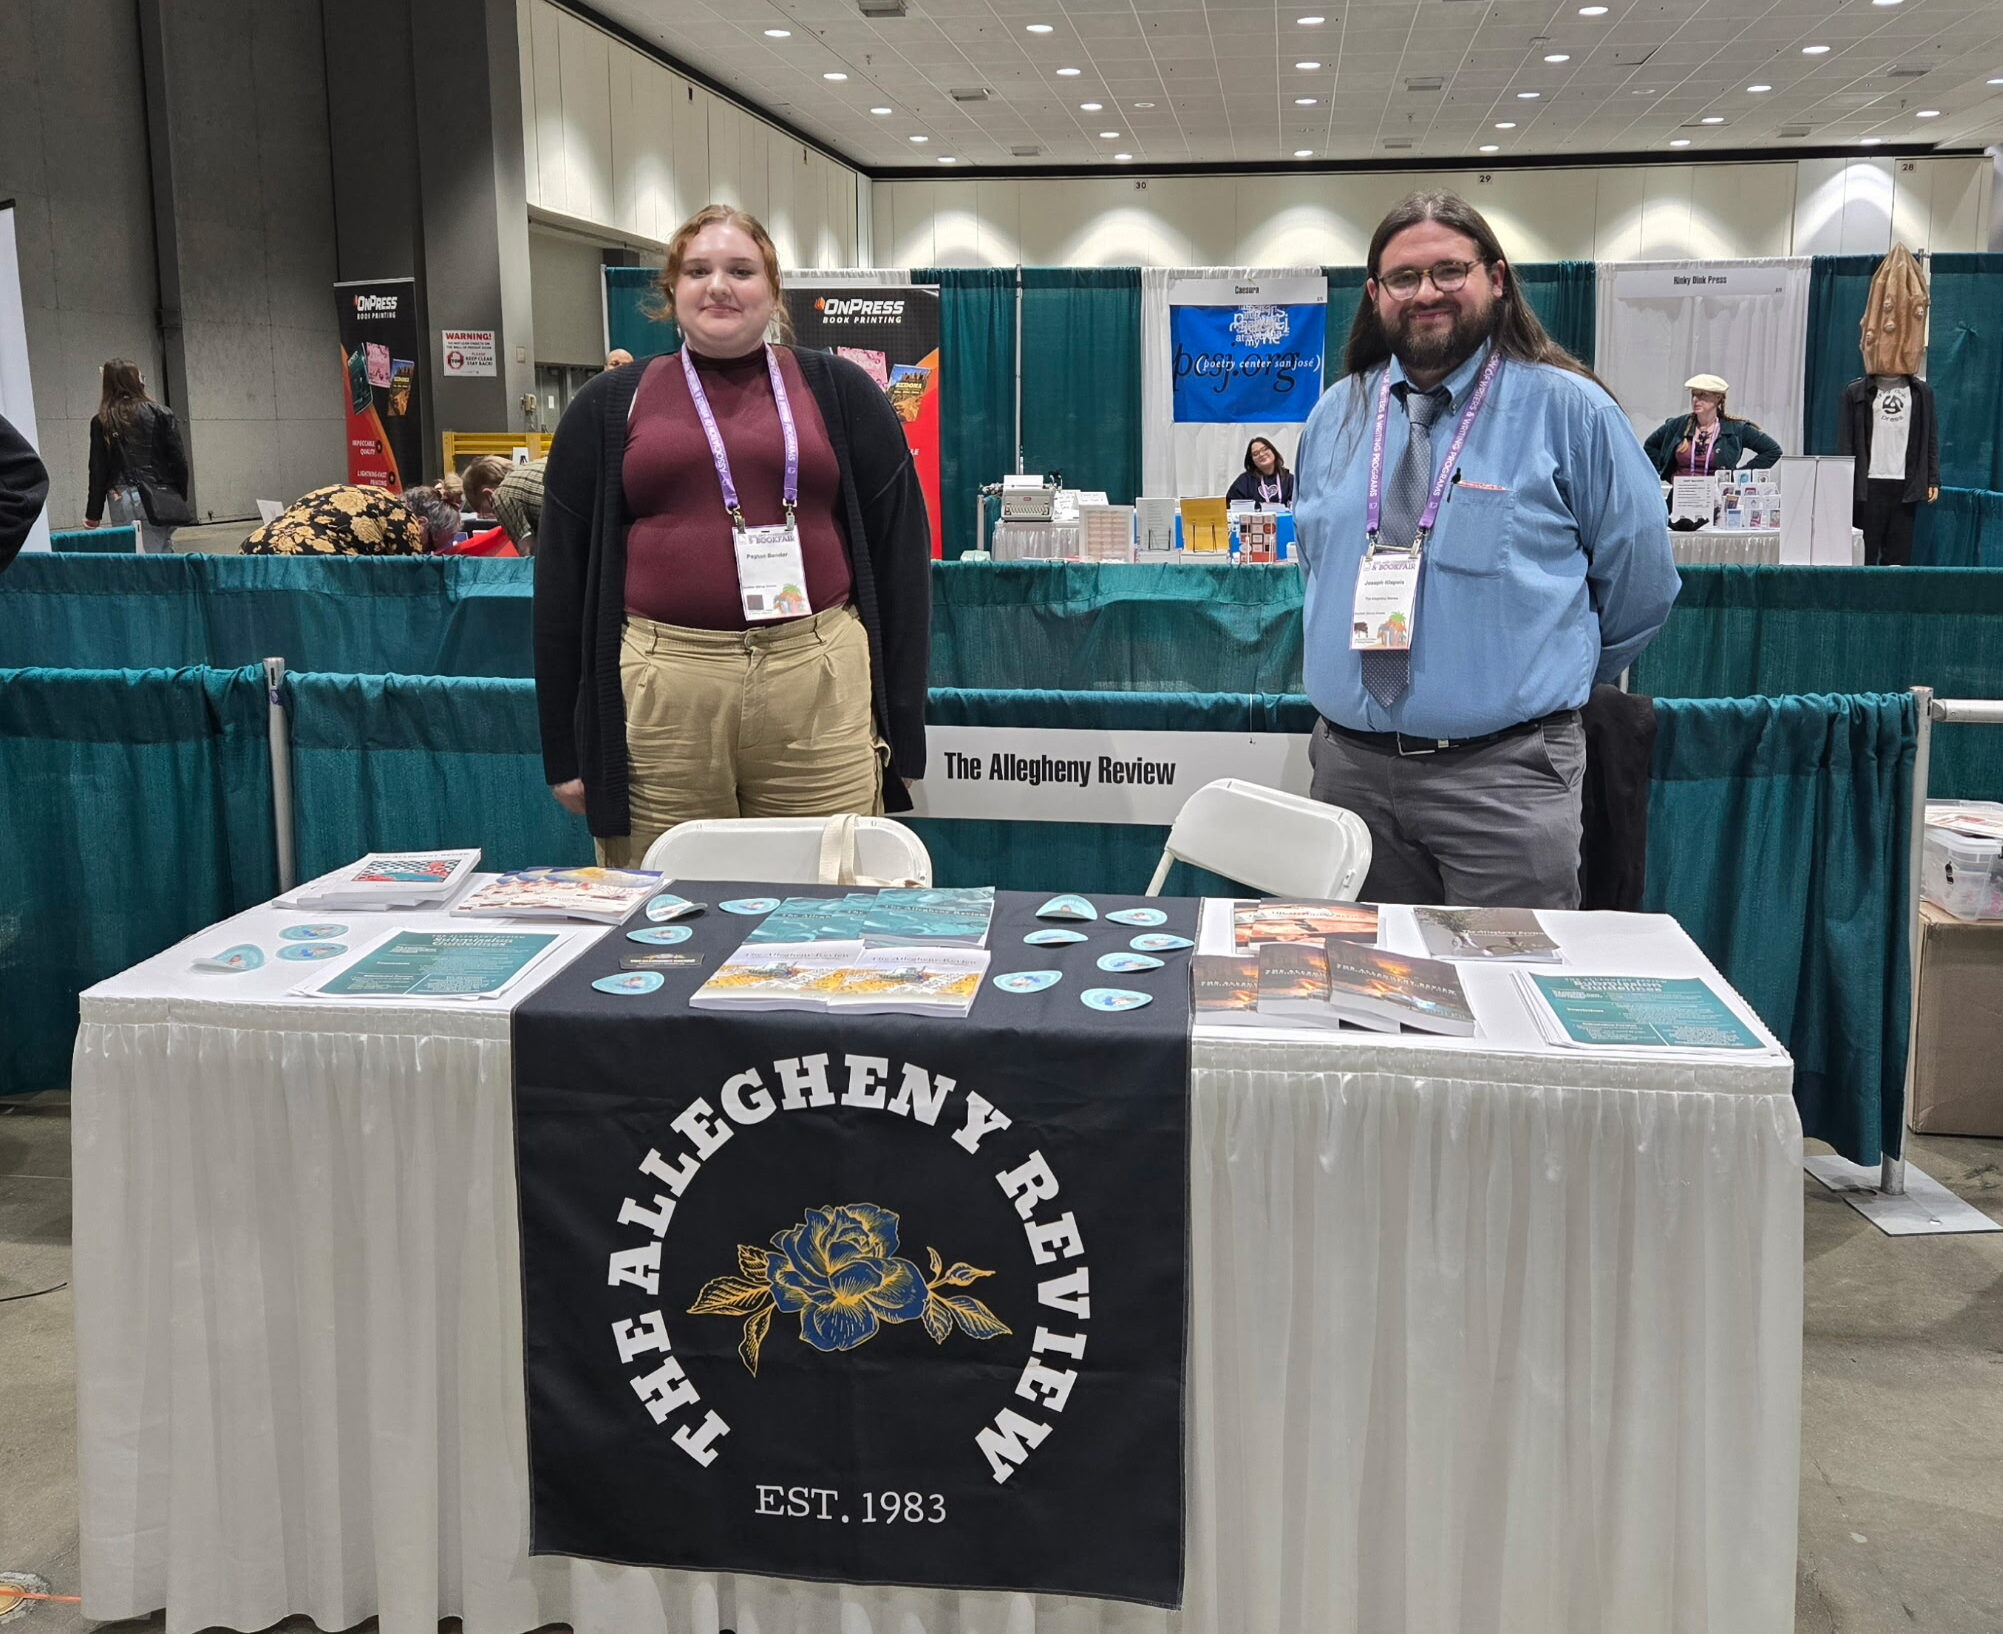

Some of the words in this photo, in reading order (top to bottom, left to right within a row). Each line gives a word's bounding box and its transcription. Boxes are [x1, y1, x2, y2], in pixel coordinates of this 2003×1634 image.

[1135, 181, 1147, 190] 30
[1479, 174, 1492, 183] 29
[1234, 285, 1260, 294] Caesura
[1692, 276, 1706, 284] Dink
[1707, 276, 1727, 284] Press
[822, 316, 850, 324] BOOK
[854, 316, 902, 324] PRINTING
[445, 332, 492, 340] WARNING!
[1172, 342, 1301, 393] pcsj.org
[1239, 359, 1272, 369] center
[1483, 369, 1495, 382] OF
[1469, 379, 1489, 411] WRITERS
[1451, 417, 1472, 451] WRITING
[1369, 453, 1381, 498] PROGRAMS
[1432, 452, 1457, 497] PROGRAMS
[1378, 563, 1416, 571] BOOKFAIR
[944, 751, 982, 780] The
[989, 753, 1092, 788] Allegheny
[1098, 756, 1177, 785] Review
[608, 1052, 1013, 1296] ALLEGHENY
[974, 1149, 1091, 1485] REVIEW
[611, 1309, 731, 1468] THE
